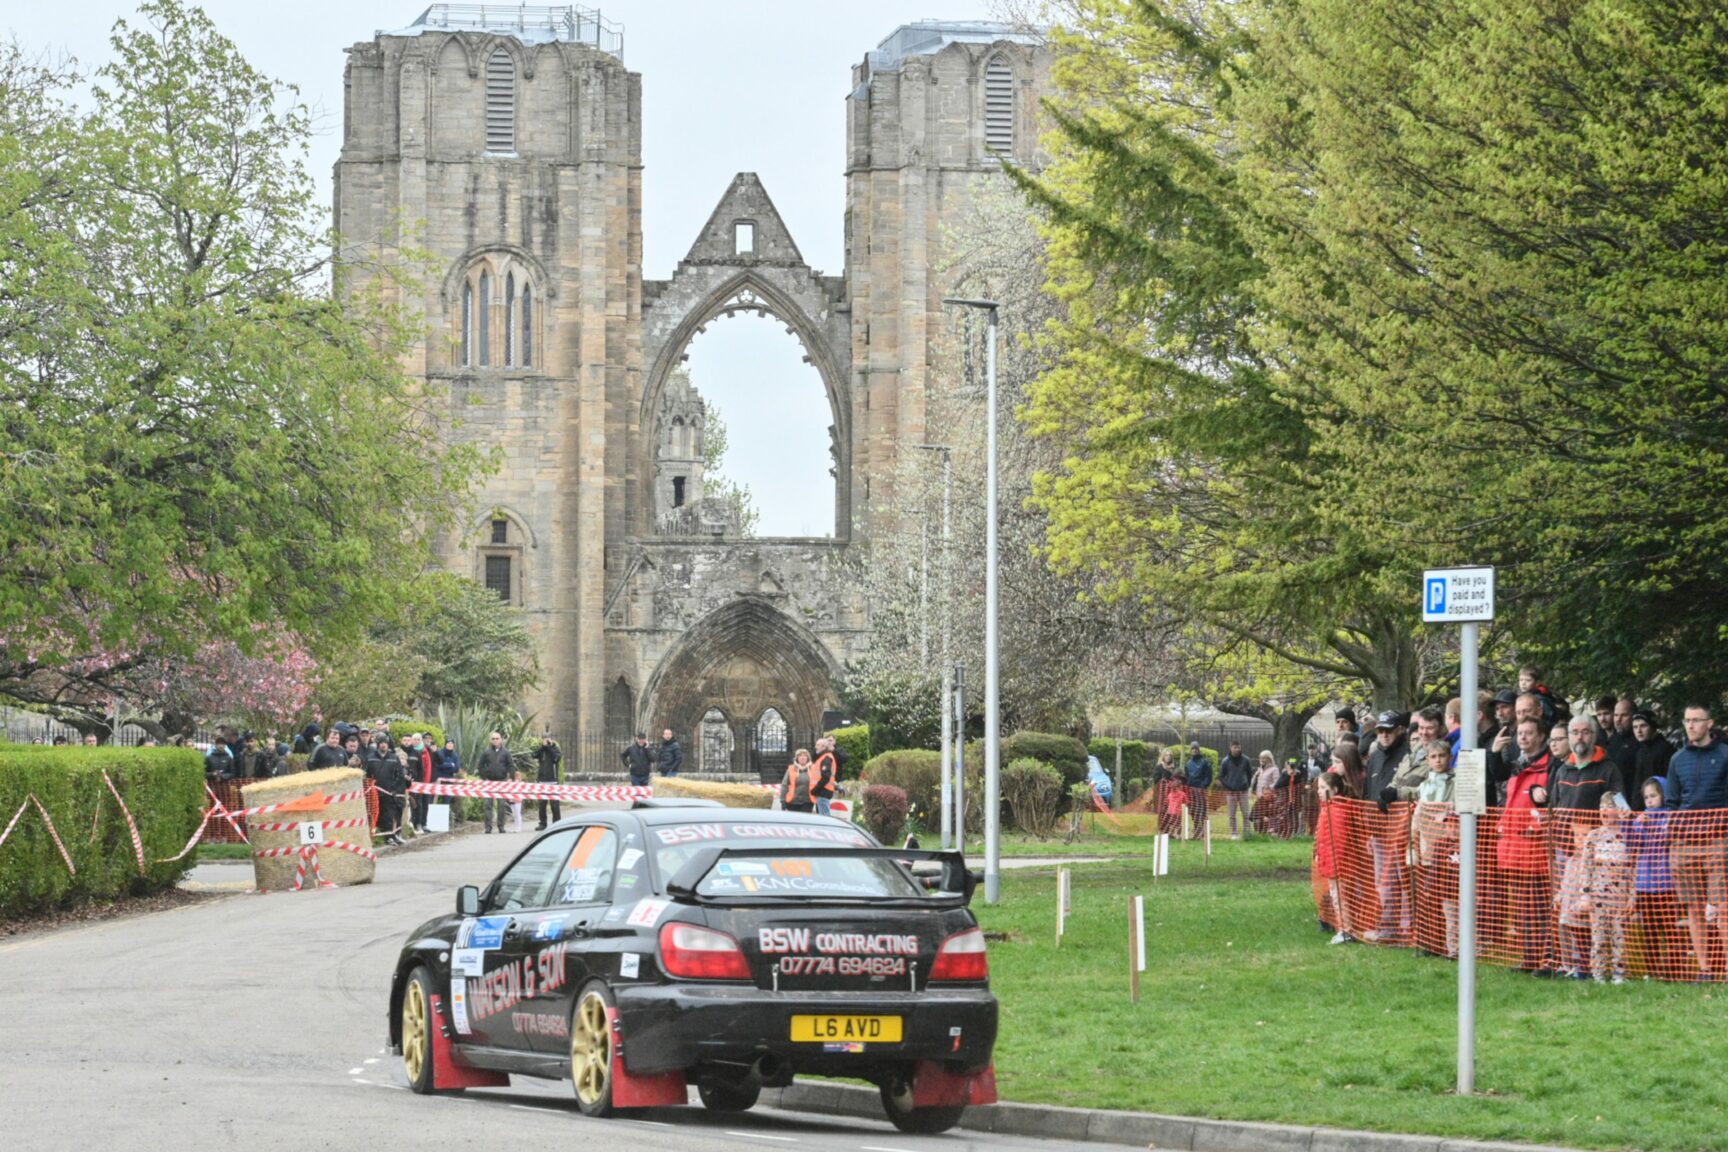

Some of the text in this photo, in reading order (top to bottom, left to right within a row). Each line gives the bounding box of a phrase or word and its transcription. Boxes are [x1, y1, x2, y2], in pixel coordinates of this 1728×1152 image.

[1452, 576, 1487, 587] Have you
[1453, 588, 1486, 602] paid and
[308, 825, 315, 840] 6
[655, 823, 870, 848] BSW CONTRACTING
[756, 877, 808, 890] KNC
[758, 928, 919, 955] BSW CONTRACTING
[780, 956, 906, 976] 07774 694624
[468, 959, 521, 1021] WATSON
[524, 955, 536, 998] &
[538, 941, 568, 993] SON
[813, 1018, 881, 1038] L6 AVD
